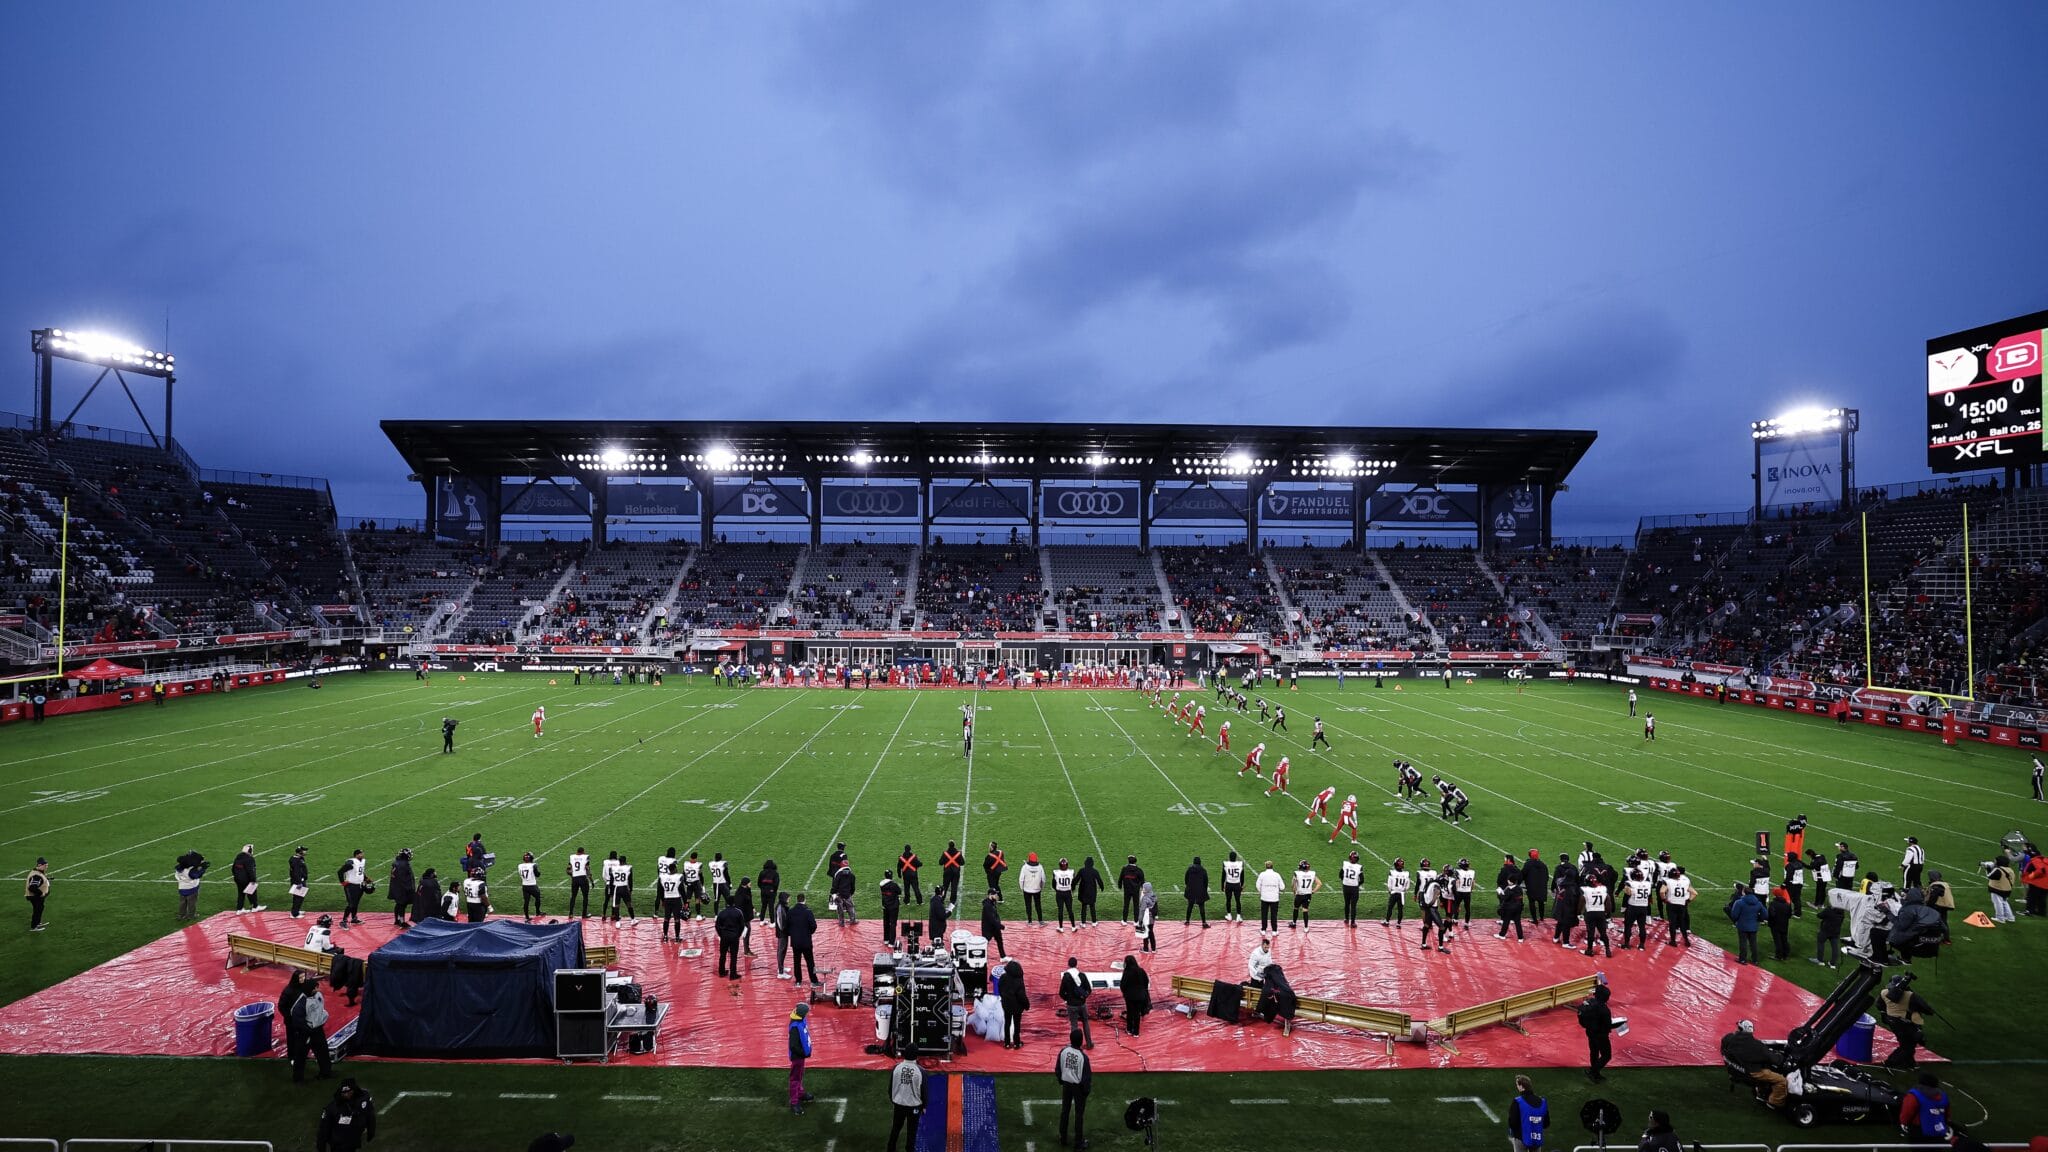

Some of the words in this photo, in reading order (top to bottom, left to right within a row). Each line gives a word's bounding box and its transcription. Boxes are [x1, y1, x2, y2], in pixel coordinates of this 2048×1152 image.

[1971, 343, 1993, 353] XFL
[2012, 378, 2024, 394] 0
[1944, 392, 1955, 406] 0
[1959, 397, 2008, 419] 15:00
[1989, 427, 2008, 437] Ball
[2010, 424, 2025, 434] On
[2027, 420, 2042, 431] 25
[1931, 435, 1947, 445] 1st
[1948, 433, 1963, 442] and
[1965, 430, 1978, 440] 10
[1954, 440, 2014, 461] XFL
[1783, 463, 1832, 479] INOVA
[742, 493, 778, 514] DC
[942, 496, 979, 509] Audi
[1291, 497, 1350, 508] FANDUEL
[625, 504, 678, 515] Heineken
[189, 638, 208, 646] XFL
[473, 662, 505, 673] XFL
[1887, 716, 1901, 724] XFL
[1927, 720, 1943, 729] XFL
[1971, 728, 1989, 737] XFL
[2020, 736, 2040, 745] XFL
[935, 801, 998, 815] 50
[574, 861, 581, 872] 9
[614, 872, 626, 883] 28
[686, 869, 697, 879] 22
[1228, 868, 1240, 878] 45
[1346, 868, 1357, 880] 12
[664, 881, 676, 892] 97
[1059, 877, 1071, 887] 40
[1301, 878, 1312, 889] 17
[1395, 877, 1406, 888] 14
[1463, 877, 1473, 887] 10
[1674, 887, 1685, 898] 61
[1591, 895, 1603, 906] 71
[306, 932, 314, 945] 0
